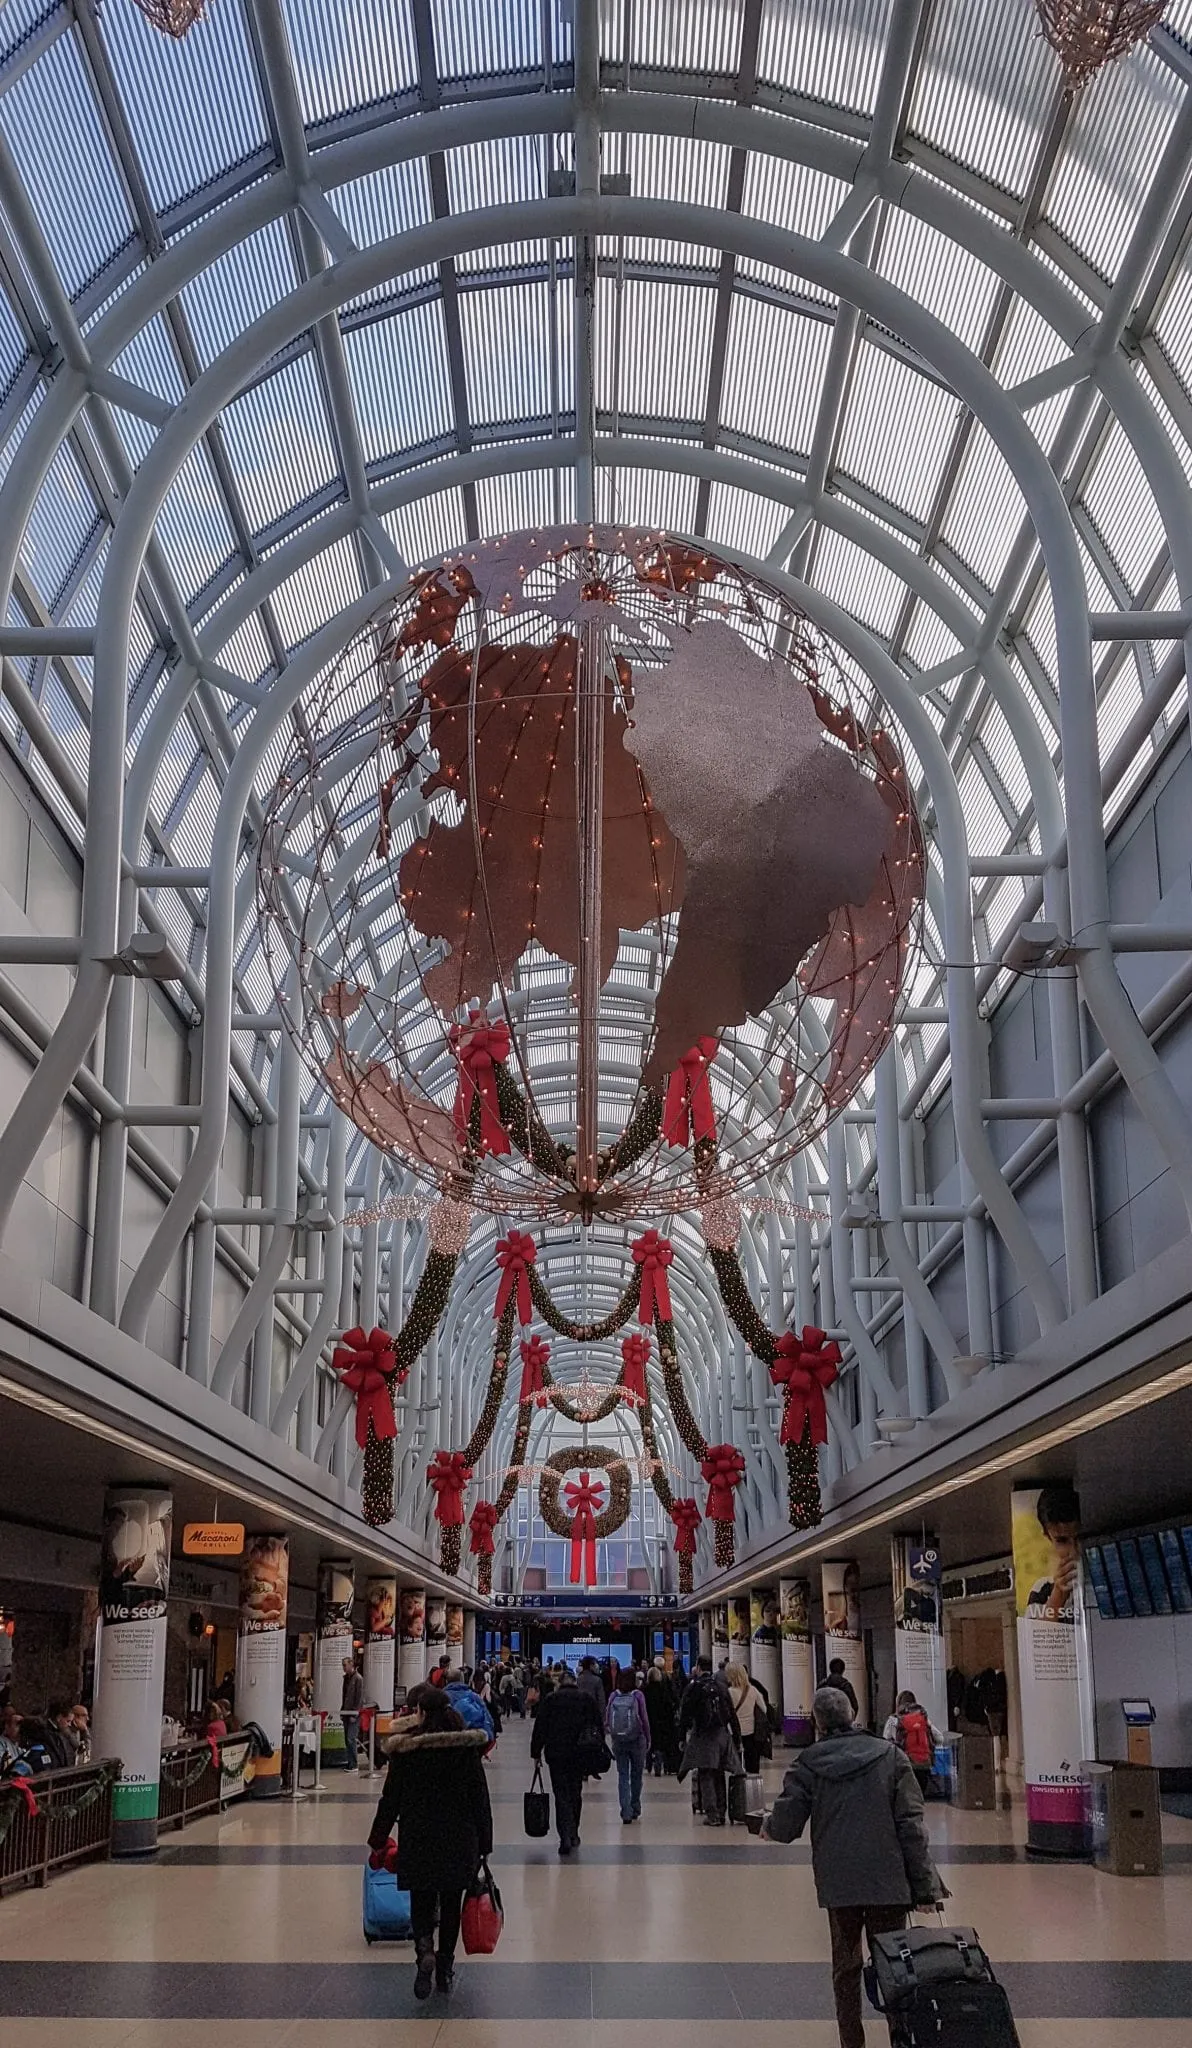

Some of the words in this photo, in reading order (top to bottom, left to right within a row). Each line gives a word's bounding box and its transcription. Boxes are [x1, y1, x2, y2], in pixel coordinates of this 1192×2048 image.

[188, 1531, 239, 1541] Macaroni
[106, 1604, 129, 1618] We
[131, 1606, 156, 1618] see
[1030, 1604, 1055, 1618] We
[1058, 1606, 1080, 1618] see
[245, 1620, 261, 1630] We
[263, 1622, 280, 1630] see
[903, 1619, 920, 1630] We
[321, 1626, 335, 1636] We
[829, 1628, 843, 1636] We
[573, 1635, 601, 1643] accenture
[1032, 1786, 1065, 1794] CONSIDER
